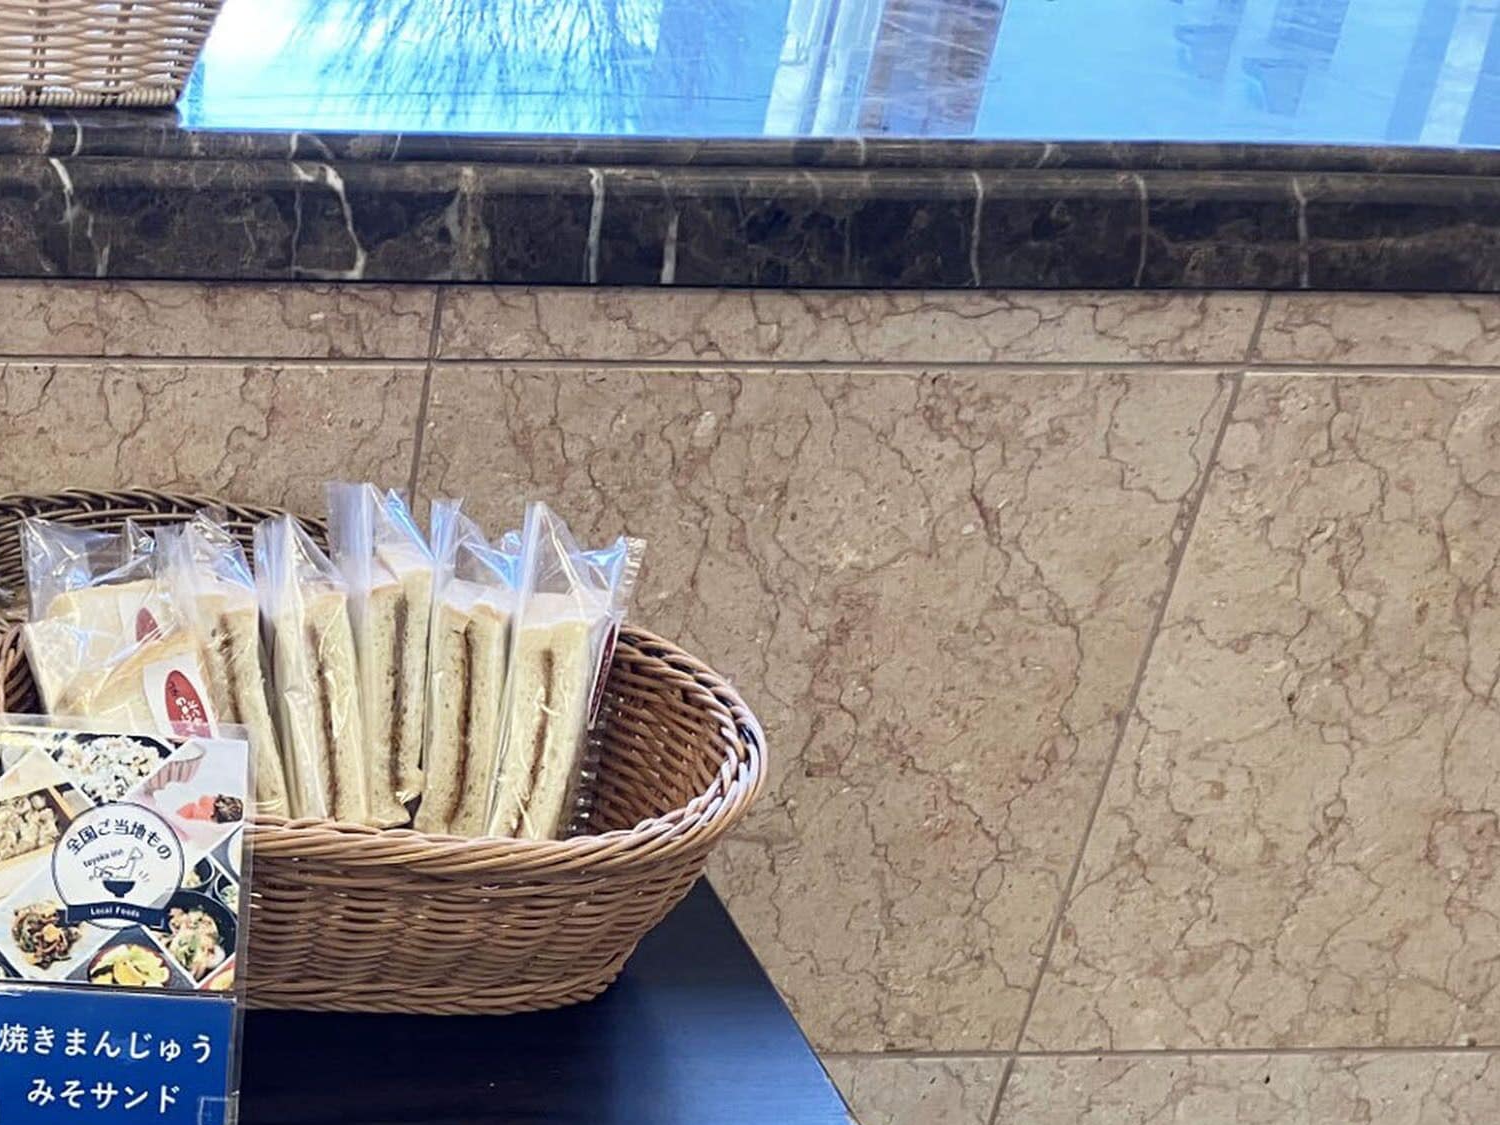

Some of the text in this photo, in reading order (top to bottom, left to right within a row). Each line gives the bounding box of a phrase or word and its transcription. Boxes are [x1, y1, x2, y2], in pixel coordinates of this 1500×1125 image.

[66, 819, 172, 860] 全国ご当地もの
[90, 907, 140, 918] Local Foods
[0, 1023, 212, 1063] 焼きまんじゅう
[27, 1078, 180, 1113] みそサンド
